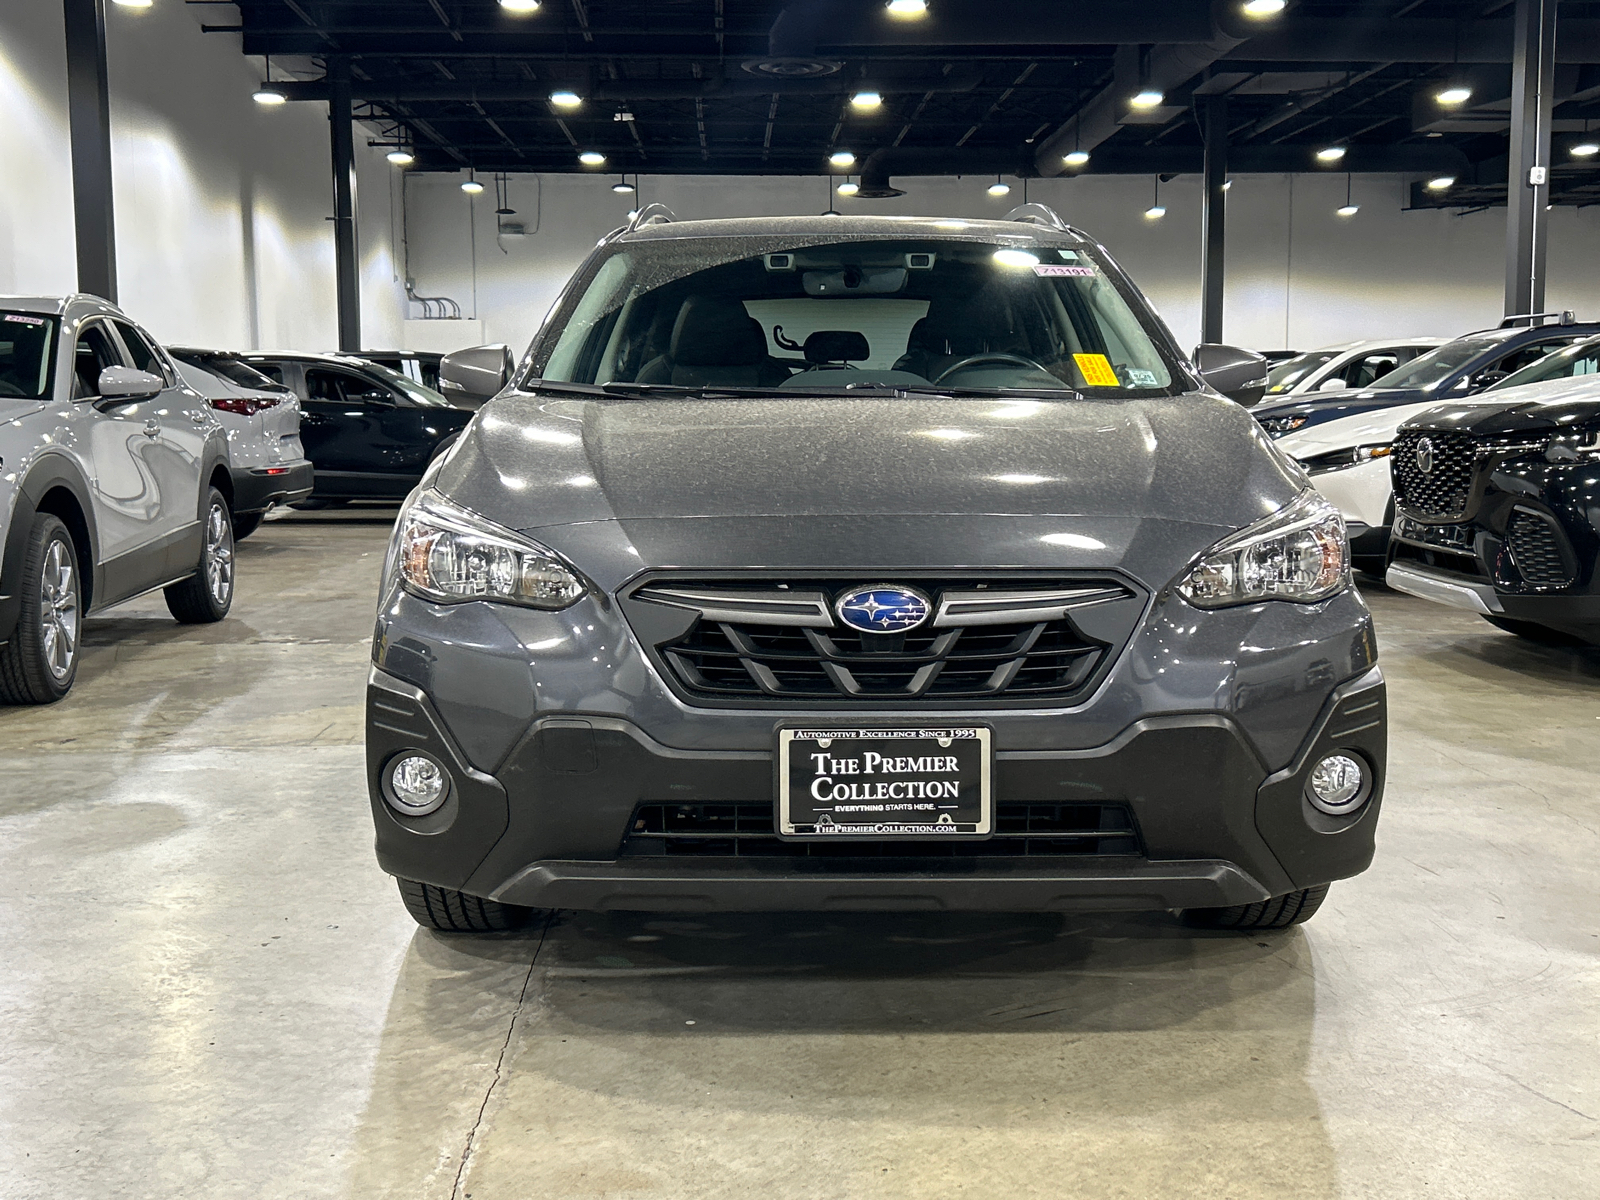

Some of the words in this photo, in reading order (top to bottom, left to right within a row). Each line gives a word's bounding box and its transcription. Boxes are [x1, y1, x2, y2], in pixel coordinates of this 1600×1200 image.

[796, 730, 857, 739] AUTOMOTIVE
[859, 730, 917, 738] EXCELLENCE
[918, 730, 947, 738] SINCE
[949, 729, 975, 738] 1995
[810, 752, 860, 775] THE
[863, 751, 960, 774] PREMIER
[810, 776, 960, 801] COLLECTION
[834, 804, 884, 812] EVERYTHING
[885, 803, 913, 811] STARTS
